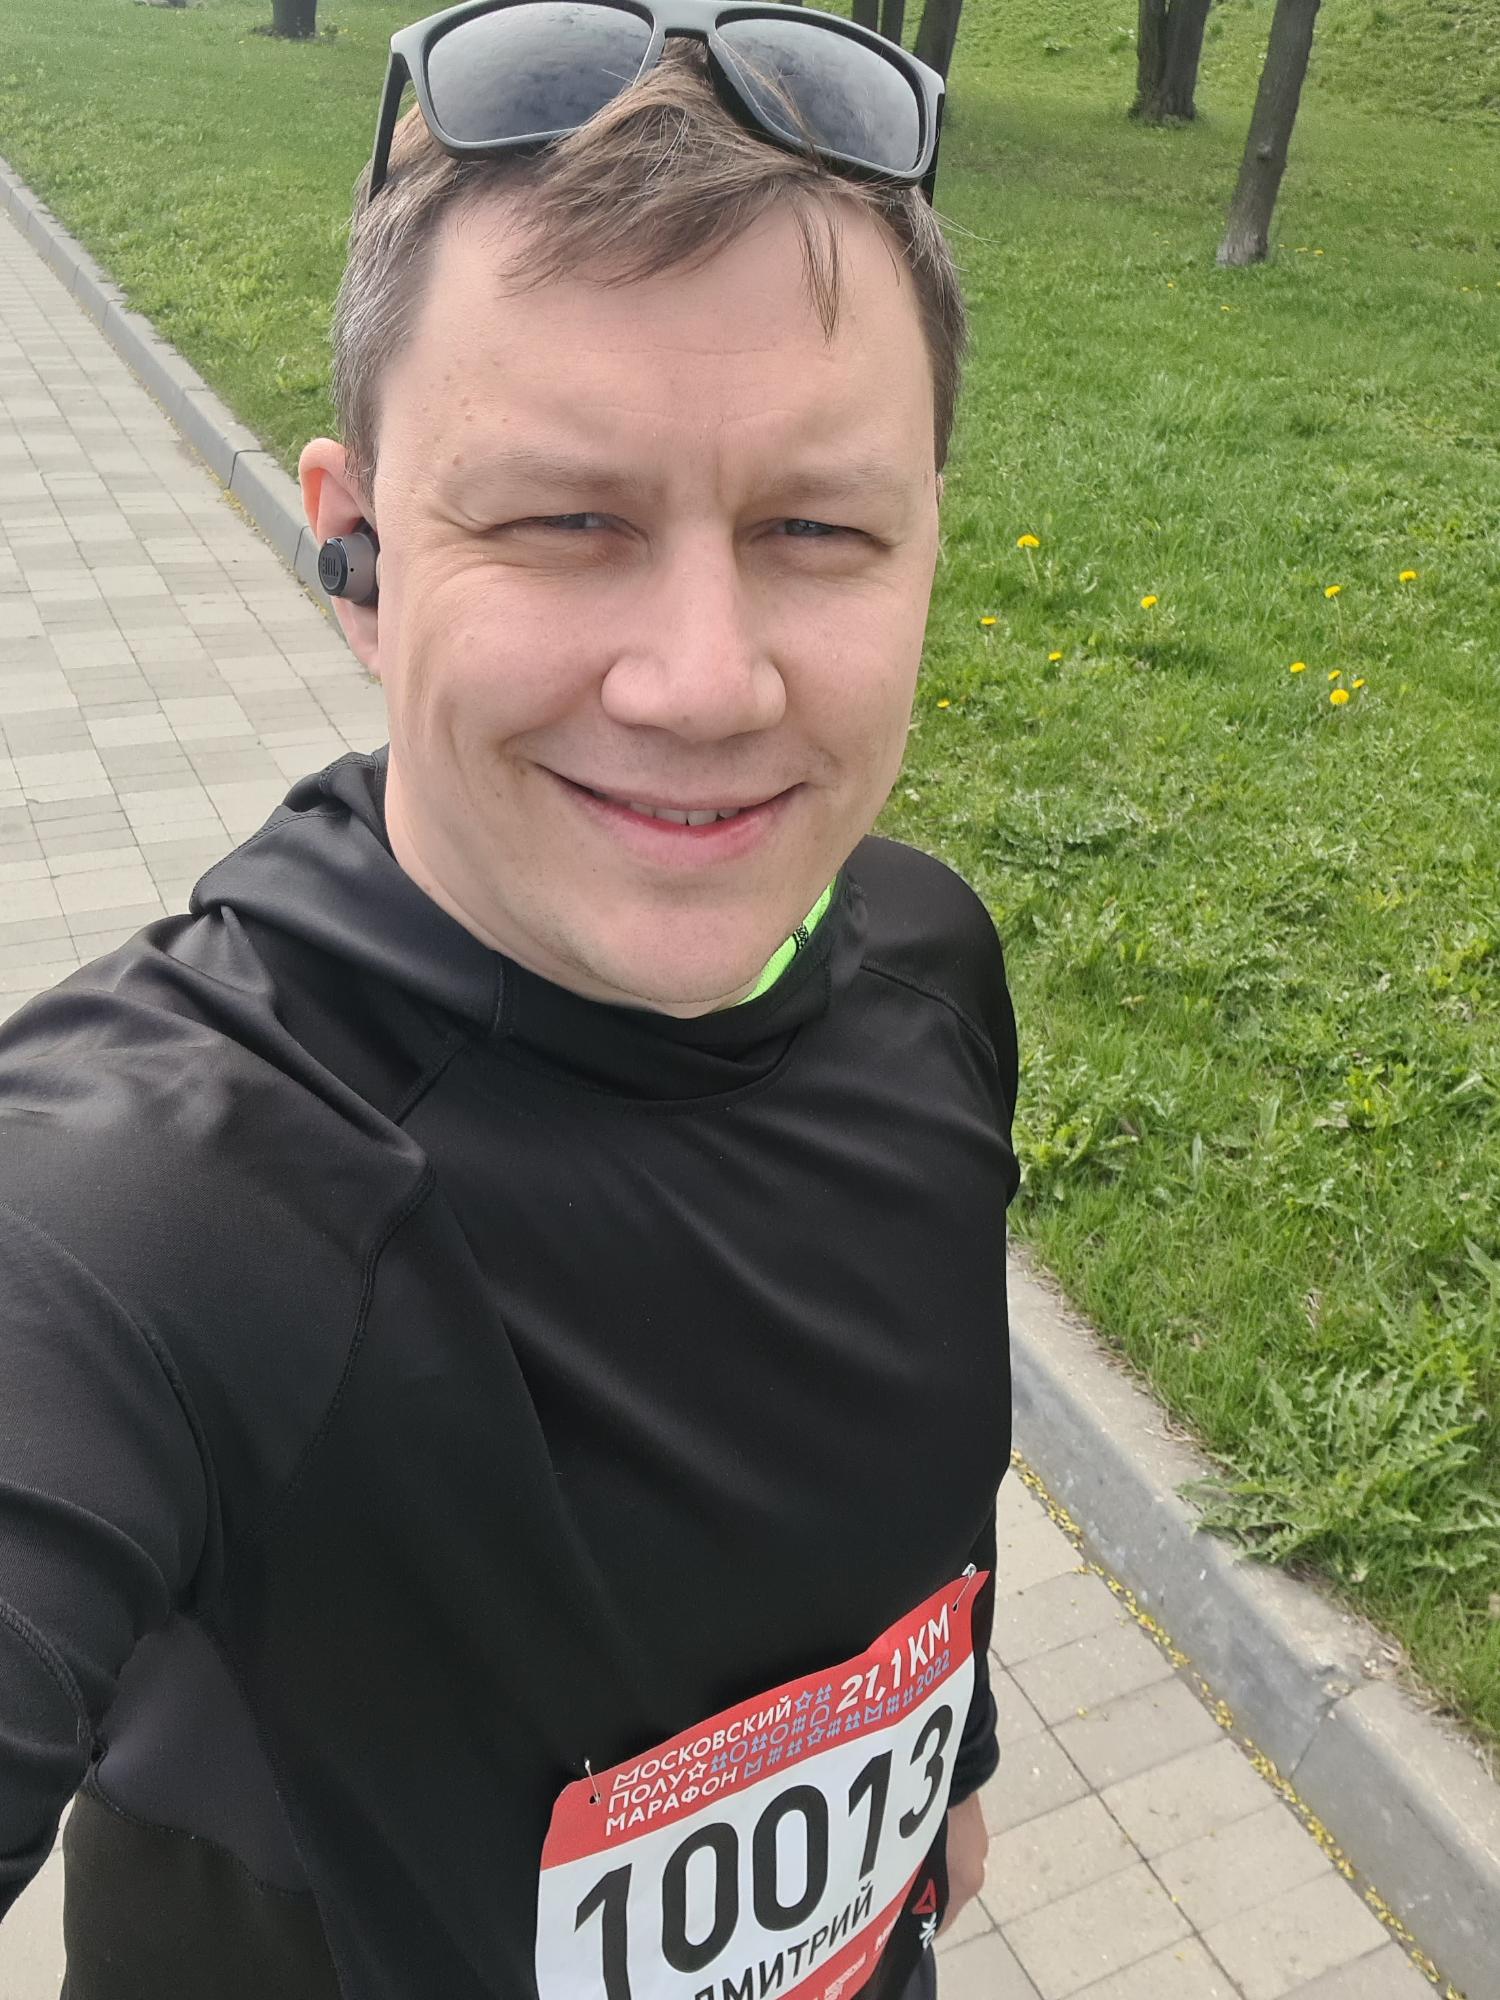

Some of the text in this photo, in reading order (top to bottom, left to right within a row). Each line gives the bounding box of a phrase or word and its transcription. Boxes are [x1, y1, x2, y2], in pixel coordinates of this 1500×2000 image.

[836, 1603, 949, 1714] 21,1 КМ
[916, 1649, 950, 1697] 2022
[613, 1695, 791, 1792] МОСКОВСКИЙ
[606, 1766, 738, 1836] МАРАФОН
[574, 1704, 953, 2000] 10013
